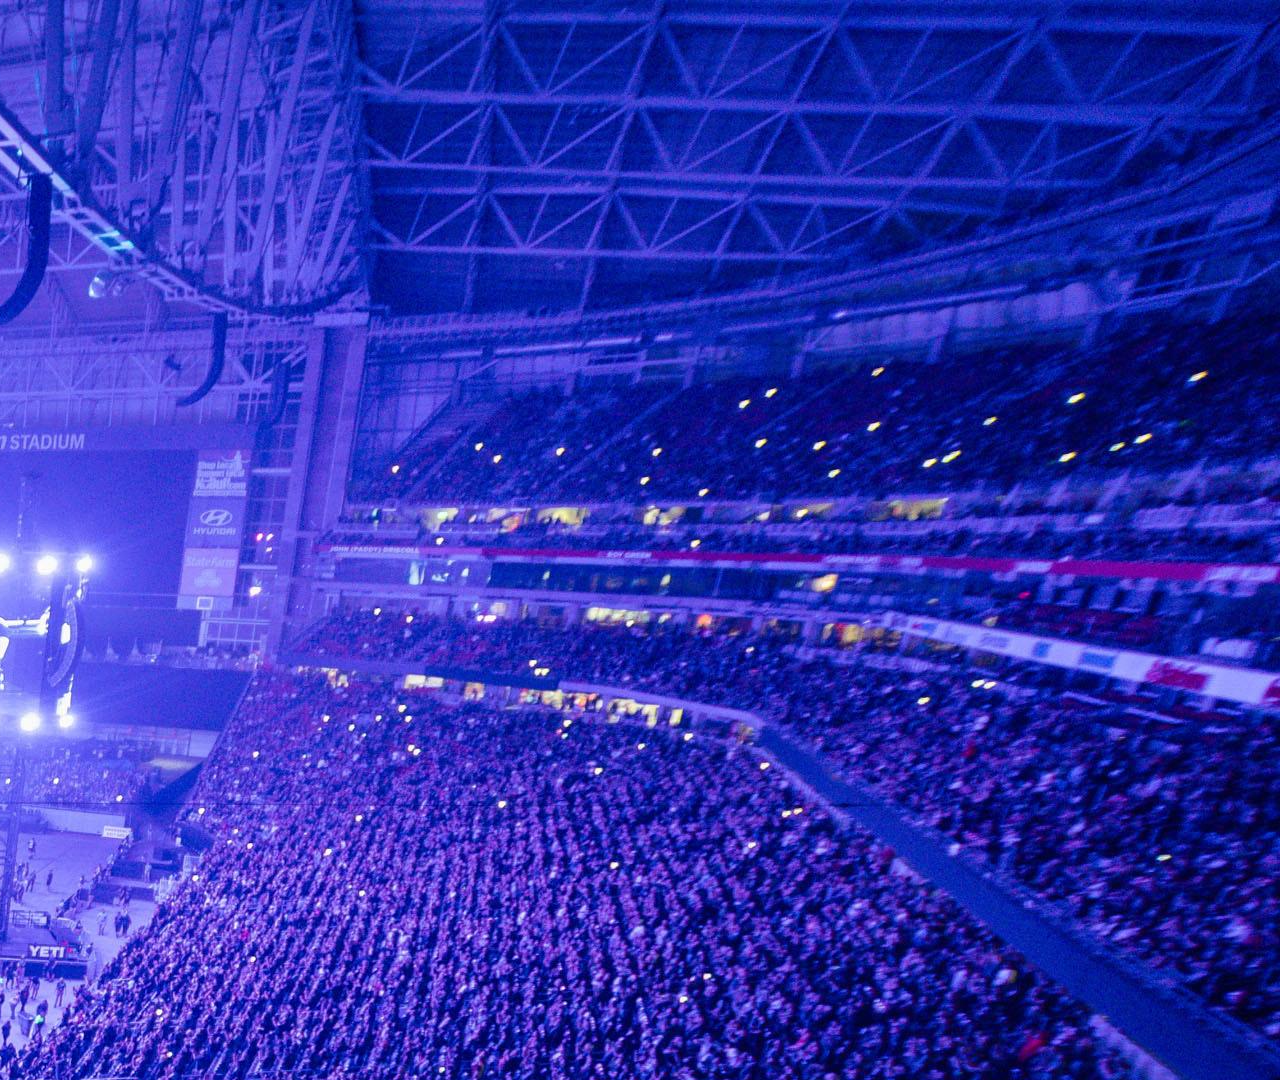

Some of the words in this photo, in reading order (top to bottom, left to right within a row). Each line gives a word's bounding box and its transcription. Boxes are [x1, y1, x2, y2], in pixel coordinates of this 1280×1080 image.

[10, 433, 85, 450] STADIUM
[193, 527, 236, 536] HYUNDAI
[29, 945, 65, 958] YETI
